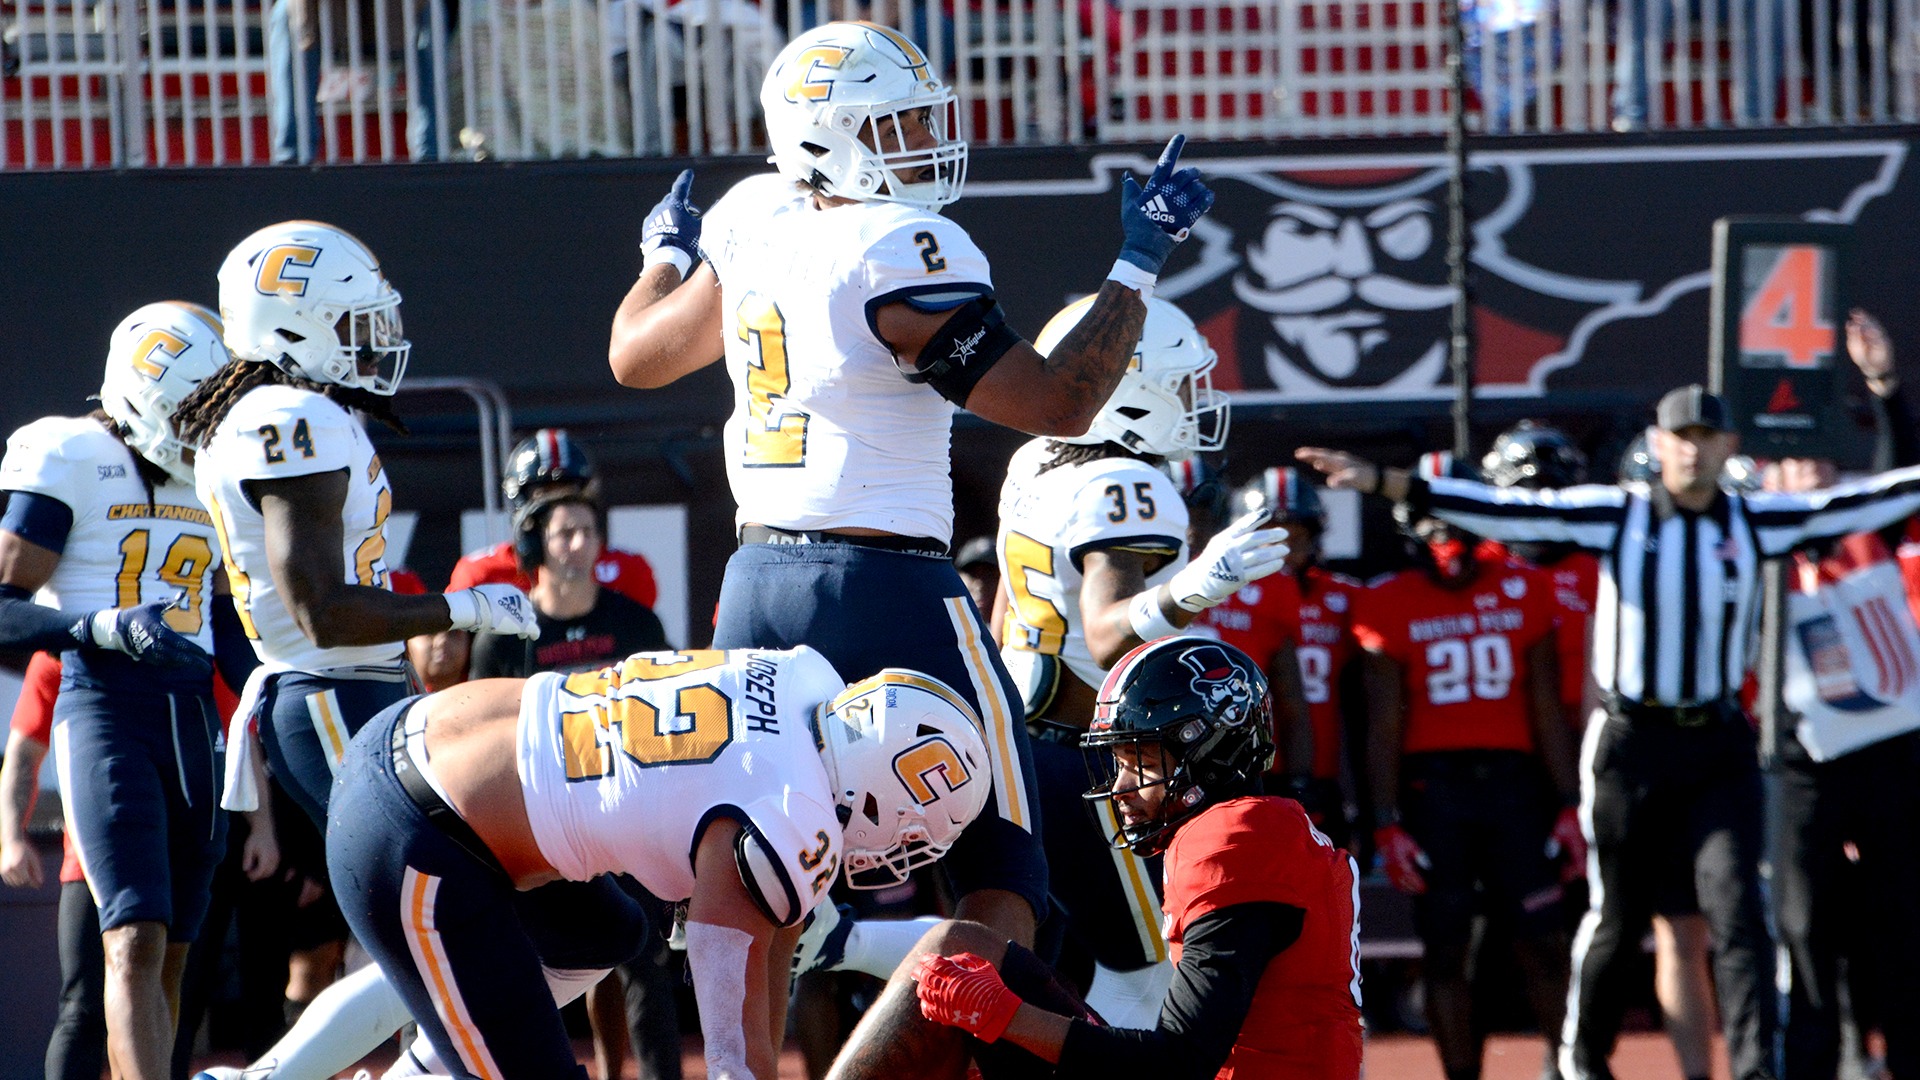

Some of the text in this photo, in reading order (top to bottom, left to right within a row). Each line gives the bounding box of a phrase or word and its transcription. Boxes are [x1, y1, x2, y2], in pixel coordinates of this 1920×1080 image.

[784, 45, 854, 104] C
[1145, 210, 1175, 223] idas
[255, 244, 323, 298] C
[914, 230, 947, 275] 2
[1738, 243, 1836, 367] 4
[131, 327, 192, 381] C
[959, 327, 986, 355] Douglas
[737, 290, 810, 468] 2
[258, 417, 317, 465] 24
[1104, 481, 1158, 524] 35
[115, 528, 212, 637] 19
[130, 620, 143, 655] adidas
[497, 598, 524, 624] adidas
[745, 653, 780, 736] JOSEPH
[1425, 634, 1515, 705] 29
[892, 736, 972, 807] C
[799, 828, 837, 897] 32
